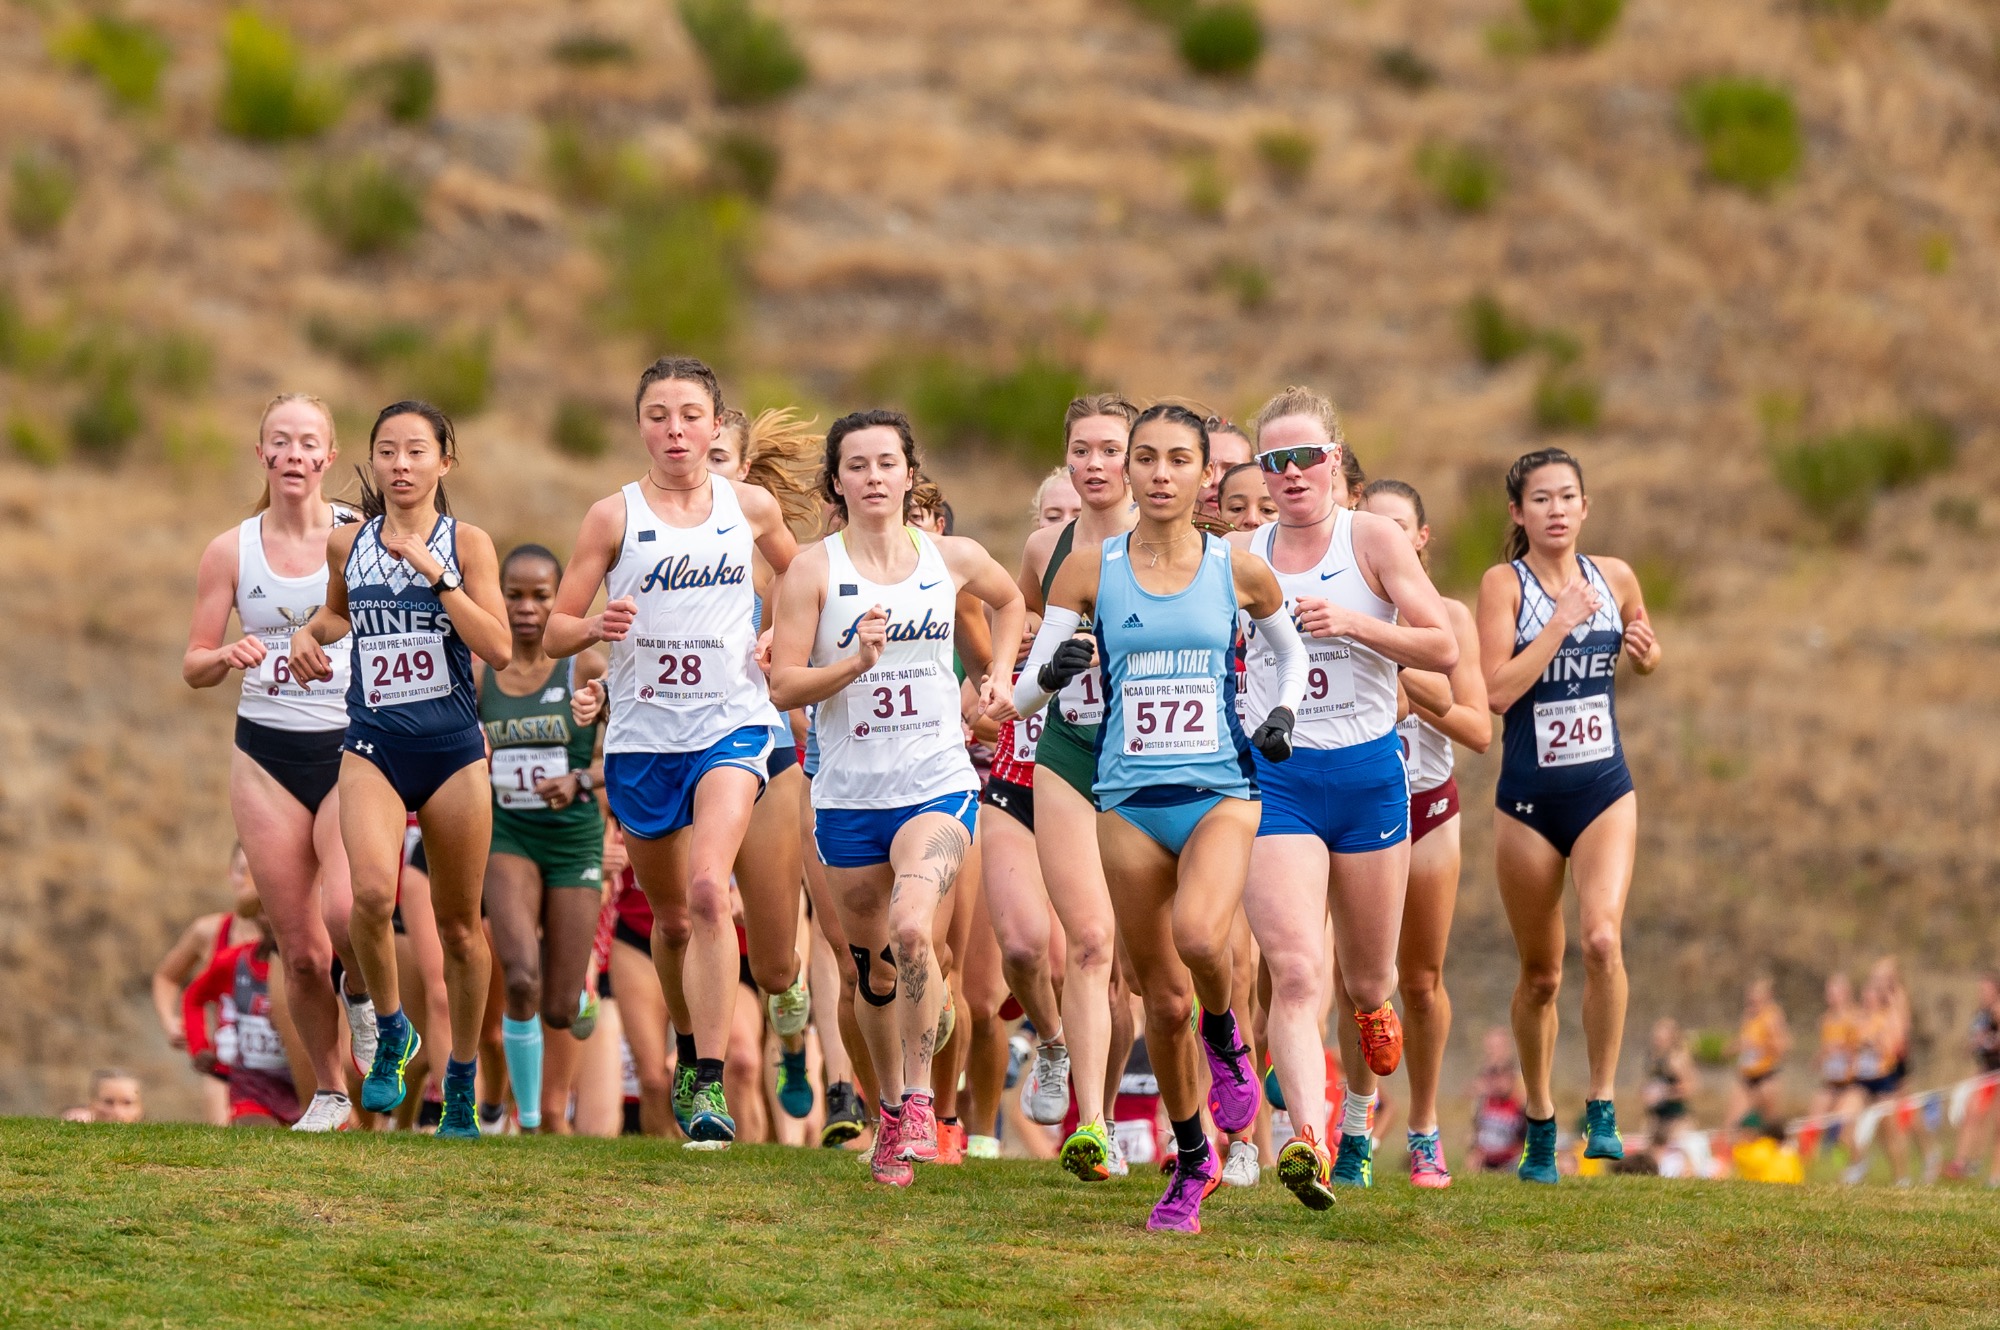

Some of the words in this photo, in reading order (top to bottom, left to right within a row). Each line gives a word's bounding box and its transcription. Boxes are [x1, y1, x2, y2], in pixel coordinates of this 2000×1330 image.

[640, 552, 746, 593] Alaska
[350, 609, 452, 636] MINES
[360, 641, 378, 651] NCAA
[387, 636, 442, 649] PRE-NATIONALS
[636, 638, 656, 648] NCAA
[667, 638, 725, 650] PRE-NATIONALS
[371, 650, 434, 687] 249
[658, 653, 702, 686] 28
[1126, 650, 1174, 676] SONOMA
[1177, 649, 1212, 674] STATE
[881, 667, 937, 682] PRE-NATIONALS
[382, 691, 400, 699] HOSTED
[408, 686, 430, 696] SEATTLE
[430, 684, 449, 693] PACIFIC
[655, 691, 673, 699] HOSTED
[674, 691, 681, 699] BY
[682, 691, 703, 699] SEATTLE
[704, 691, 723, 699] PACIFIC
[1124, 686, 1143, 696] NCAA
[1156, 684, 1215, 695] PRE-NATIONALS
[872, 684, 918, 719] 31
[1313, 704, 1335, 714] SEATTLE
[1335, 701, 1355, 710] PACIFIC
[1079, 711, 1097, 719] HOSTED
[1136, 700, 1204, 735] 572
[870, 725, 891, 733] HOSTED
[892, 724, 899, 732] BY
[900, 721, 921, 732] SEATTLE
[922, 720, 940, 729] PACIFIC
[1548, 715, 1602, 748] 246
[1144, 740, 1164, 749] HOSTED
[1165, 740, 1172, 748] BY
[1173, 740, 1195, 748] SEATTLE
[1196, 739, 1216, 747] PACIFIC
[513, 767, 546, 792] 16
